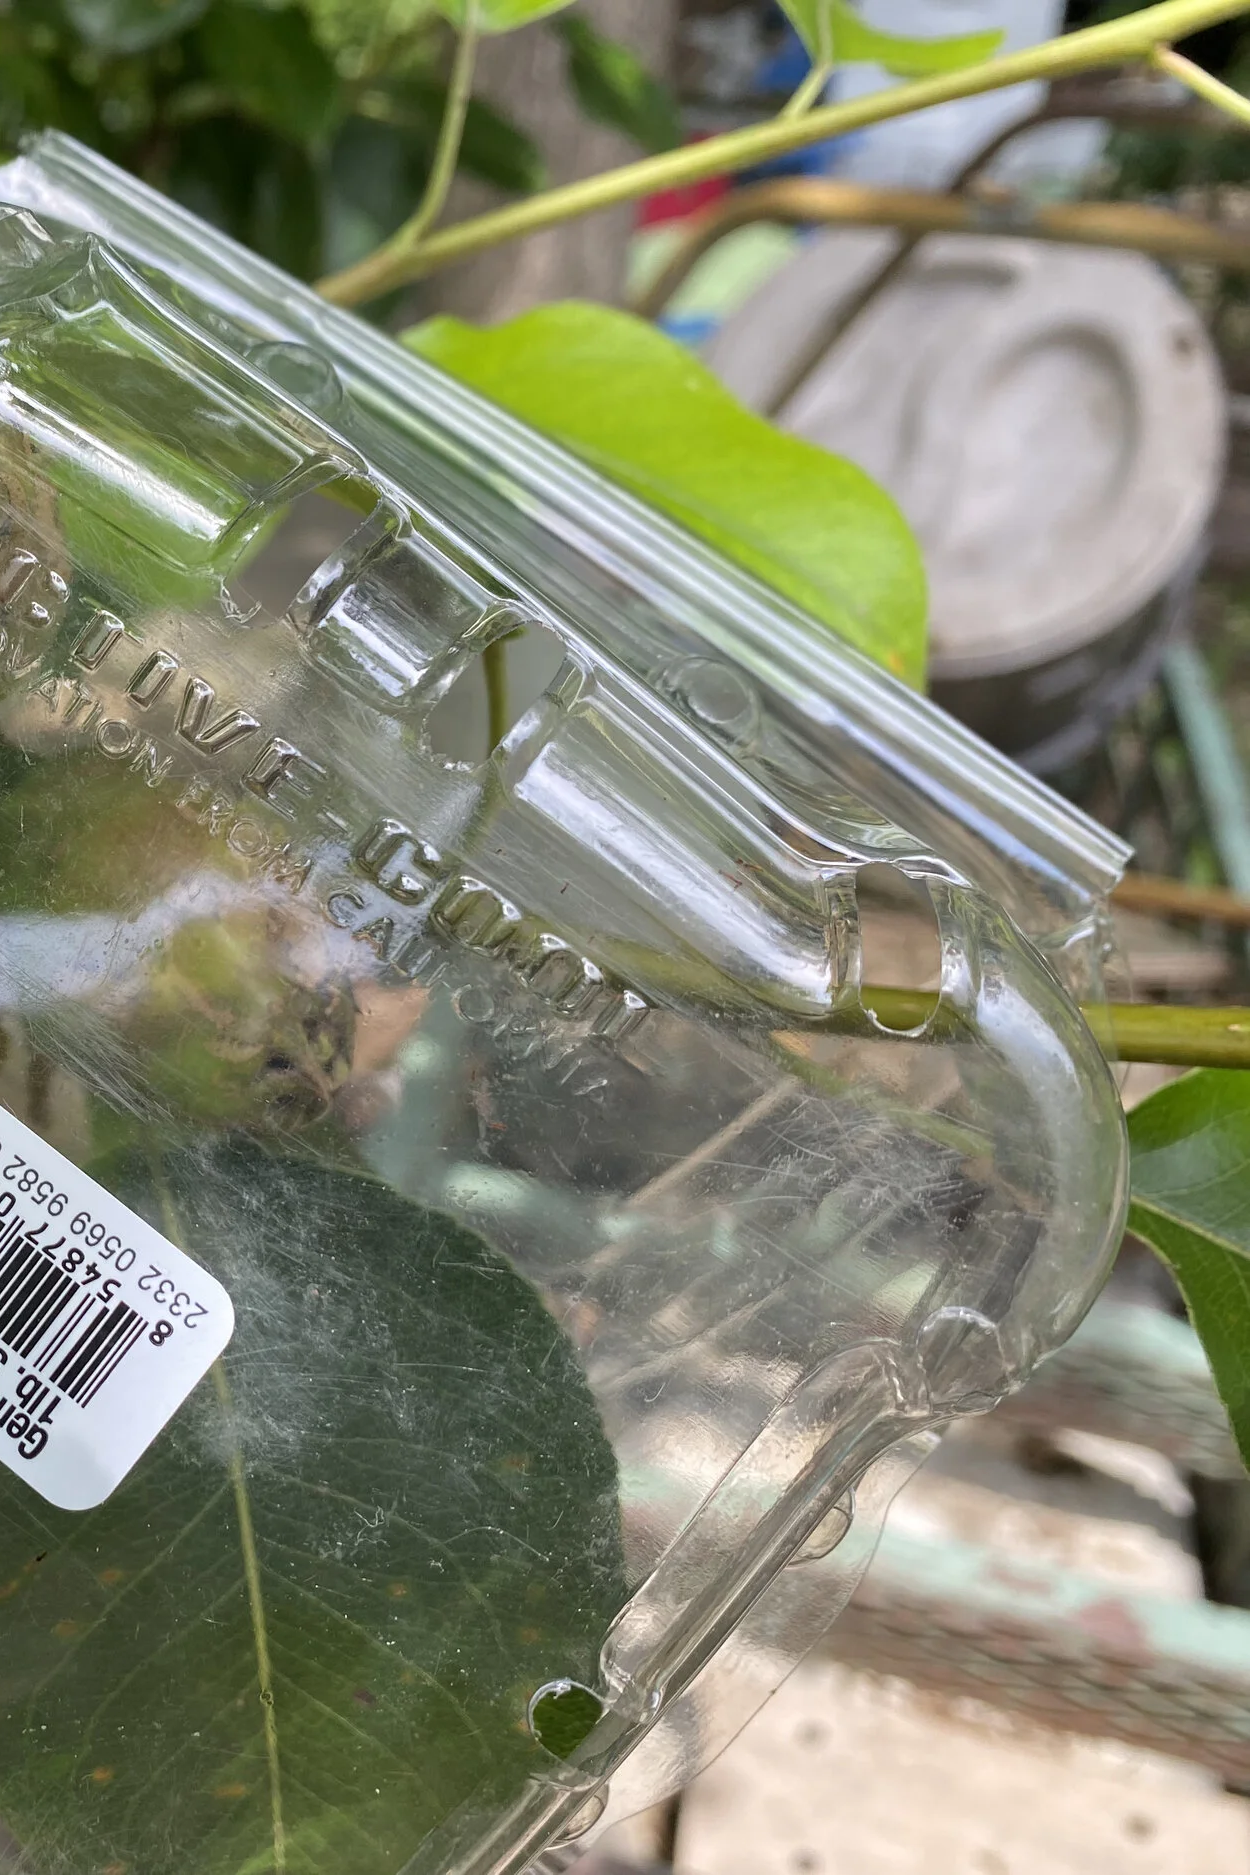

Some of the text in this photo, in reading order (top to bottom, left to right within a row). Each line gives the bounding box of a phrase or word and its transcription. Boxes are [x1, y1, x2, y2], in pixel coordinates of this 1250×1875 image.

[172, 771, 318, 896] FROM
[317, 881, 615, 1120] CALIFORNIA
[2, 1154, 69, 1217] 9582
[23, 1221, 122, 1304] 54877
[69, 1211, 136, 1272] 0569
[137, 1265, 208, 1329] 2332
[148, 1320, 174, 1347] 8
[15, 1365, 62, 1425] 1lb.
